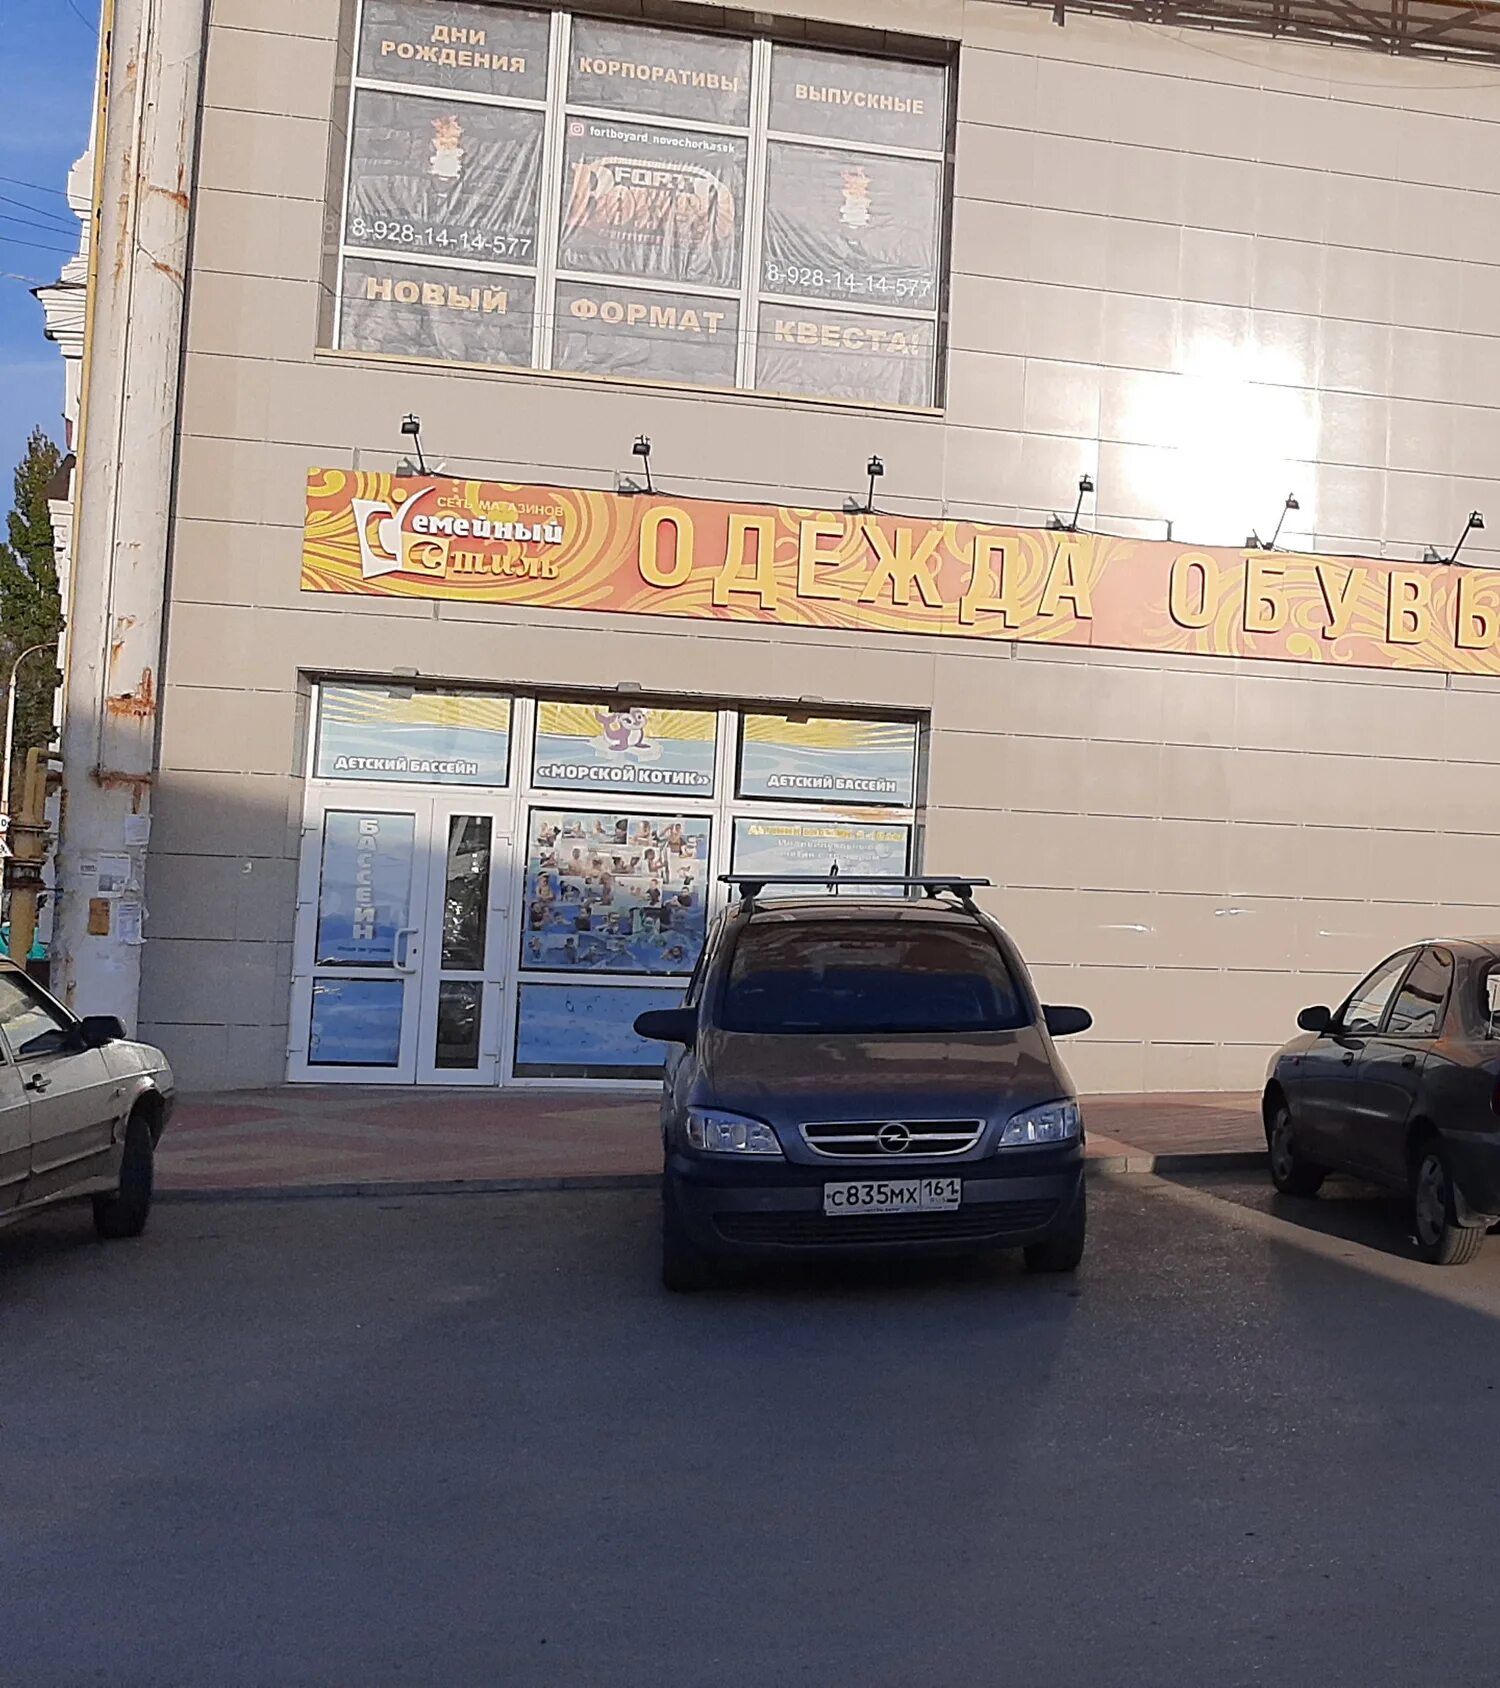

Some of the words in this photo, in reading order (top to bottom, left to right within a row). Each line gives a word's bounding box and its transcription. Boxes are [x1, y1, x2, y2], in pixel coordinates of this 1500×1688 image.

[430, 25, 487, 46] ДНИ
[381, 41, 526, 73] РОЖДЕНИЯ
[579, 56, 740, 94] КОРПОРАТИВЫ
[795, 84, 925, 116] ВЫПУСКНЫЕ
[614, 166, 693, 190] FORT
[352, 217, 532, 257] 8-928-14-14-577
[366, 276, 508, 315] НОВЫЙ
[767, 262, 931, 298] 8-928-14-14-577
[570, 297, 725, 335] ФОРМАТ
[774, 319, 920, 356] КВЕСТА!
[437, 496, 474, 510] СЕТЬ
[479, 500, 564, 517] МААЗИНОВ
[637, 506, 1094, 629] ОДЕЖДА
[334, 756, 407, 772] ДЕТСКИЙ
[408, 759, 478, 775] БАССЕЙН
[537, 764, 635, 783] «МОРСКОЙ
[637, 767, 711, 786] КОТИК»
[767, 774, 833, 789] ДЕТСКИЙ
[835, 777, 897, 793] БАССЕЙН
[352, 818, 380, 941] БАССЕЙН
[831, 1183, 918, 1207] С835МХ
[923, 1179, 958, 1197] 161
